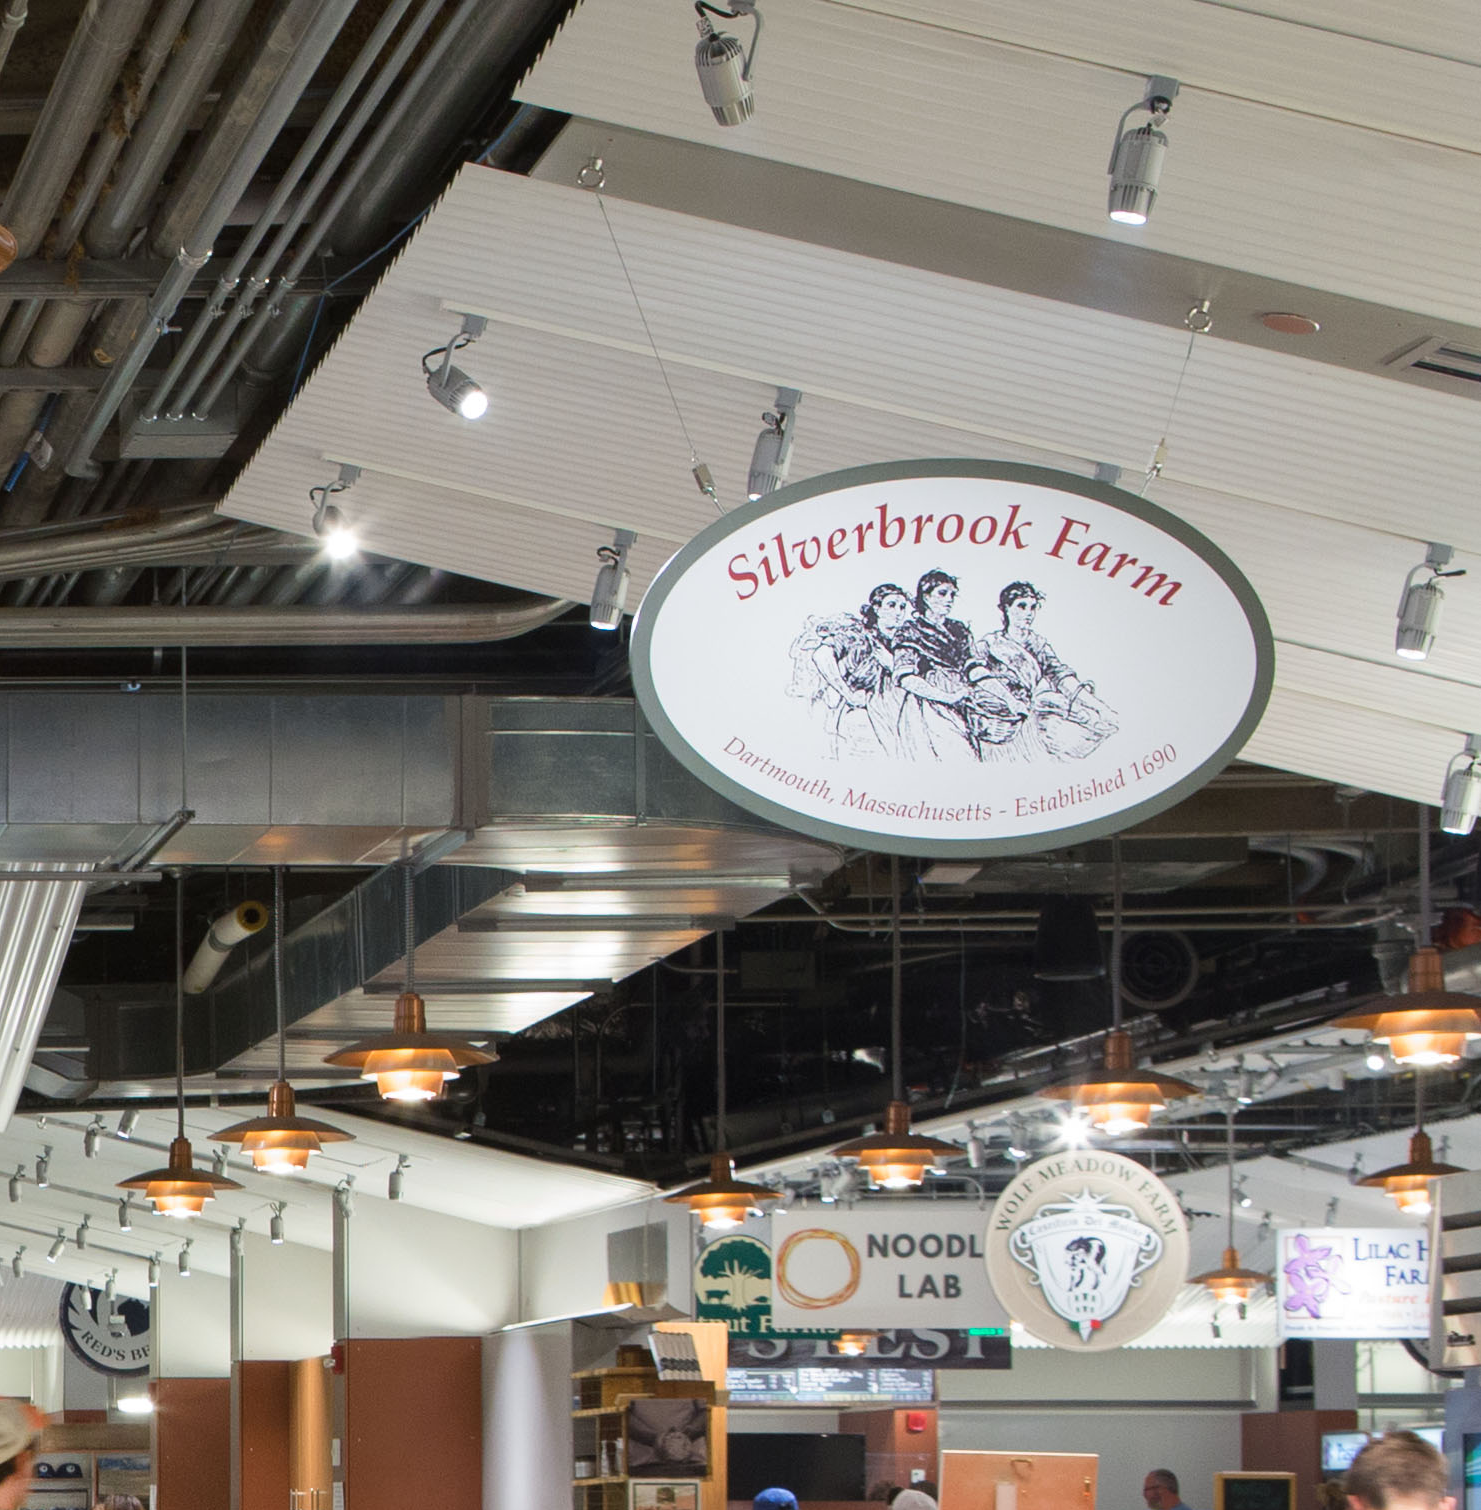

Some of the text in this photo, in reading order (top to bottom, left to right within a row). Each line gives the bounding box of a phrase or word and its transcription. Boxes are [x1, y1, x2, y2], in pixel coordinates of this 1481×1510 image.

[727, 502, 1184, 607] Silverbrook Farm
[722, 735, 1178, 822] Dartmouth, Massachusetts Established 1690
[995, 1158, 1179, 1236] WOLF MEADOW FARM
[866, 1233, 984, 1258] NOODL
[1353, 1237, 1410, 1261] LILAC
[898, 1274, 962, 1299] LAB
[81, 1330, 150, 1361] RED'S BE
